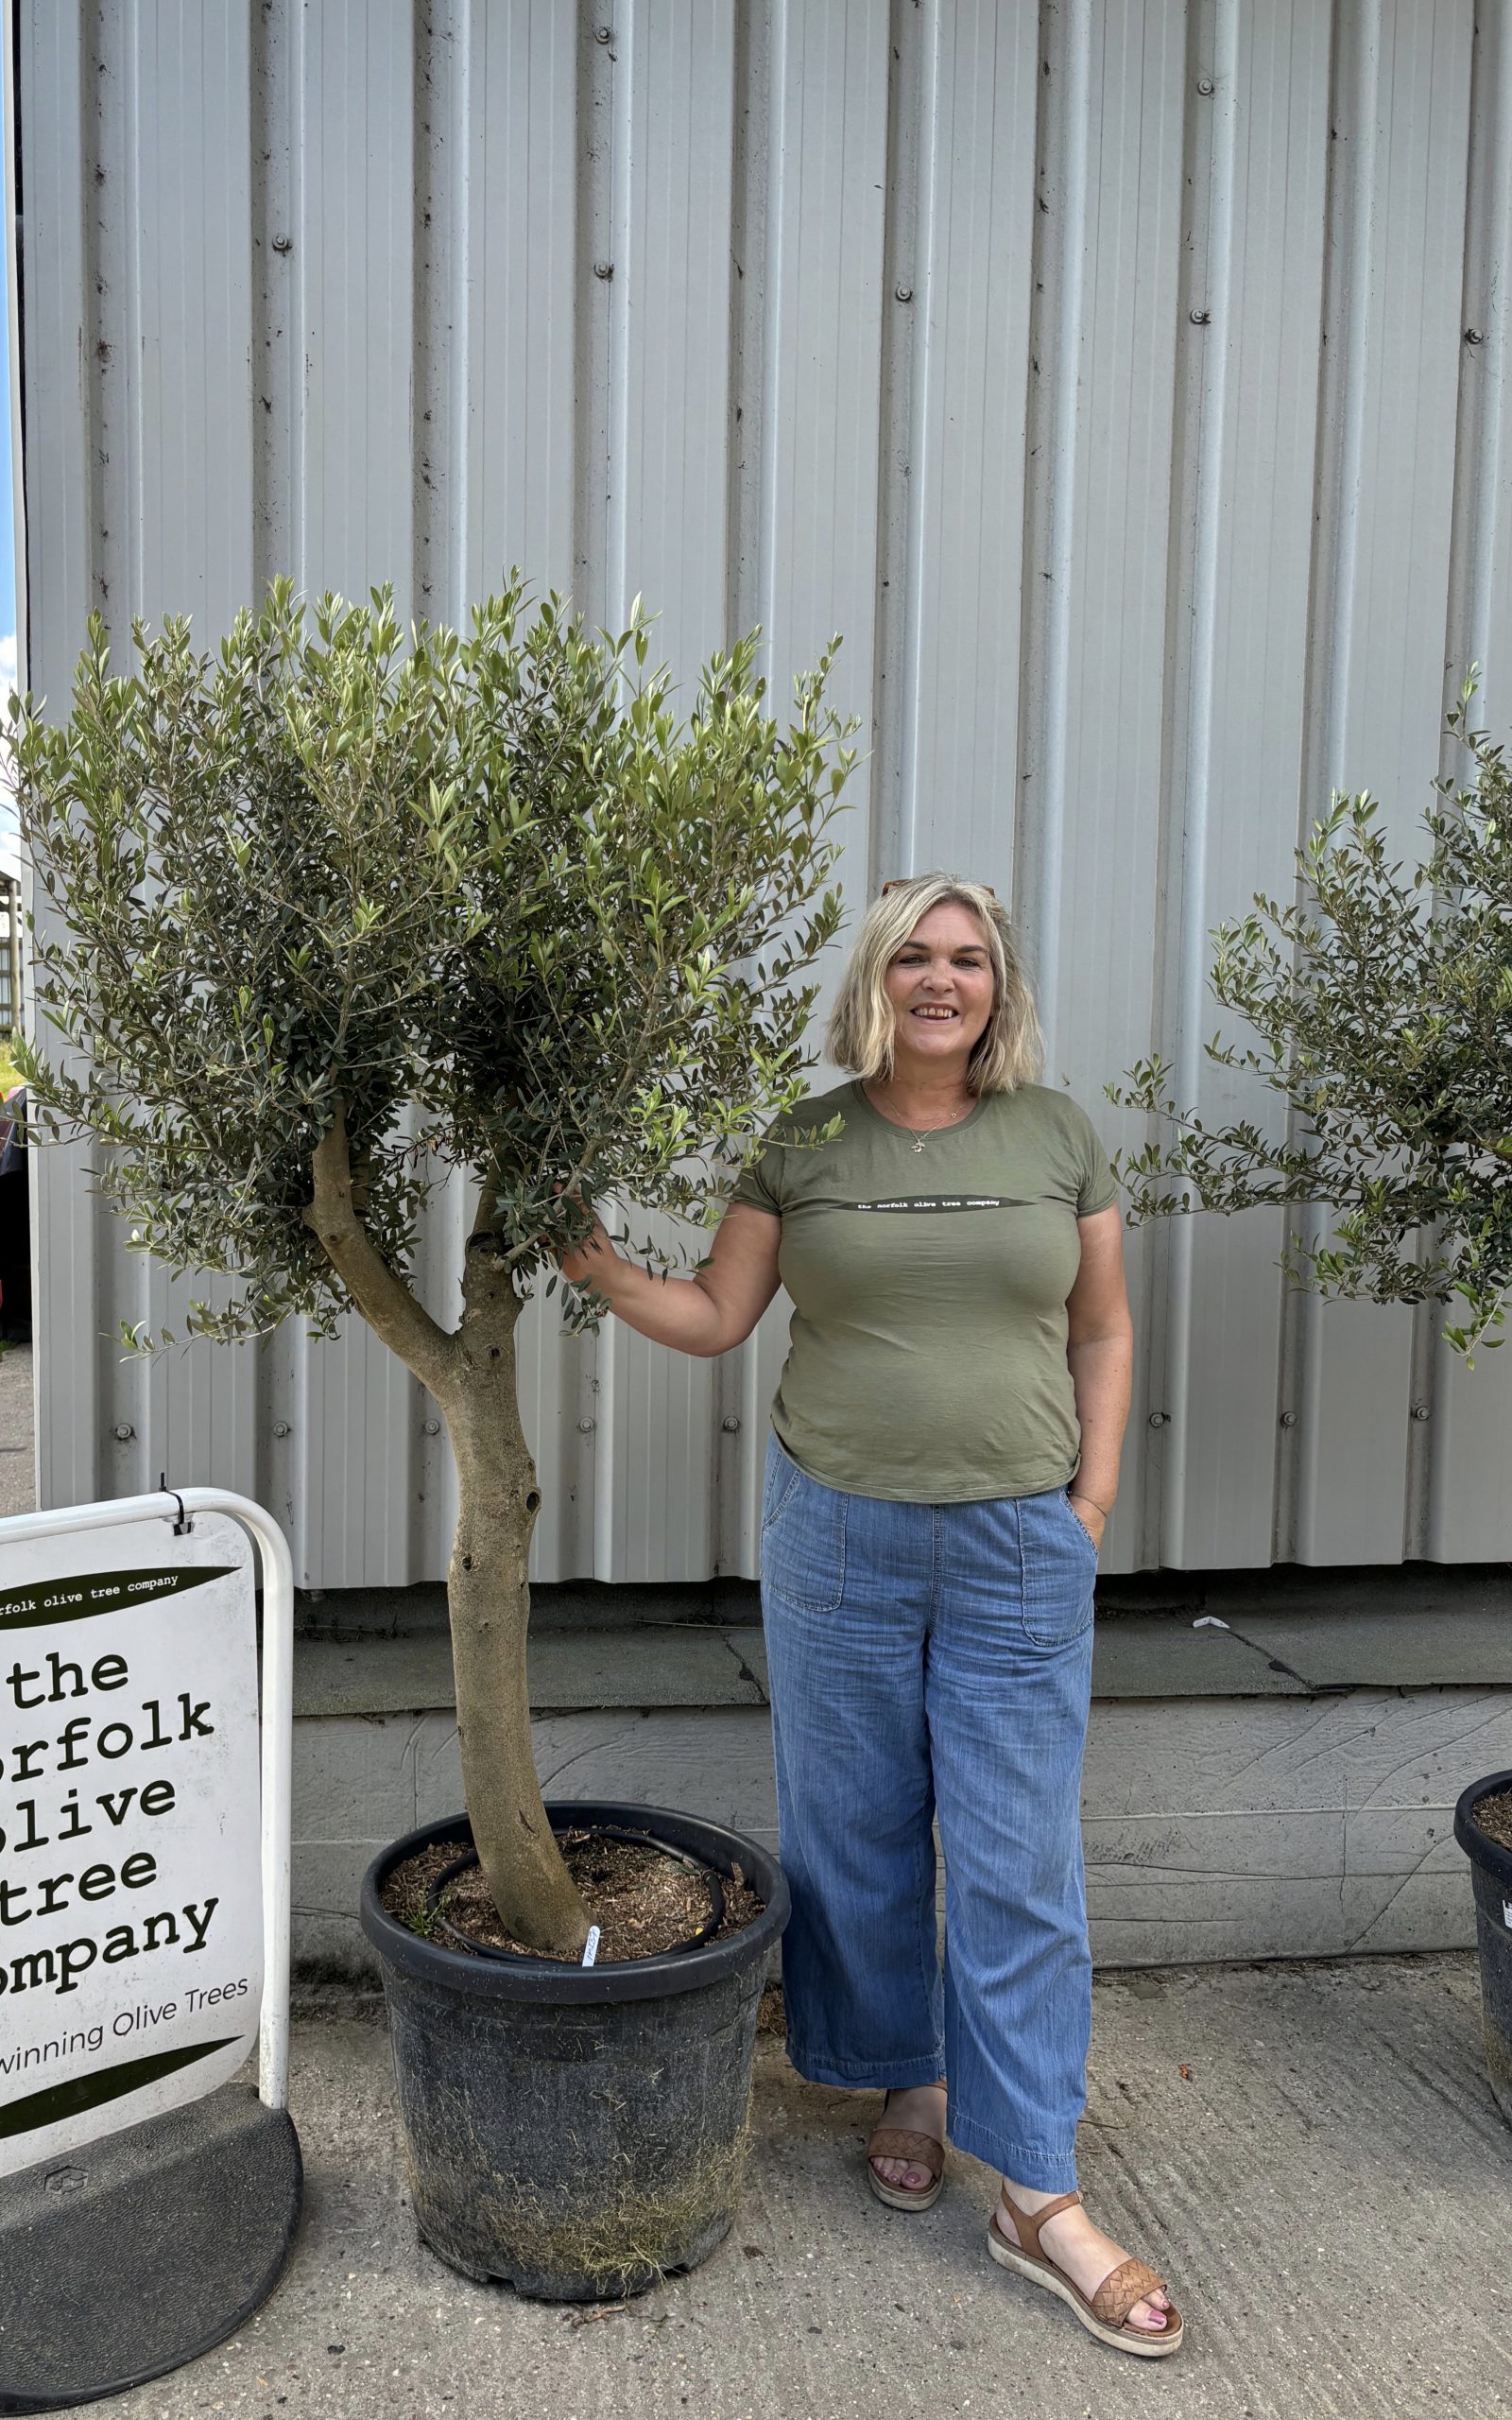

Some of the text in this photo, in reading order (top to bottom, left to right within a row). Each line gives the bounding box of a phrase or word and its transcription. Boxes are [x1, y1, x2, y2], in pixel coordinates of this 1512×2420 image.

[43, 1593, 83, 1608] olive
[90, 1586, 121, 1599] tree
[127, 1575, 179, 1592] company
[6, 1651, 129, 1709] the
[0, 1692, 215, 1783] rfolk
[0, 1779, 176, 1854] live
[0, 1852, 157, 1927] tree
[0, 1897, 219, 1996] mpany
[112, 2001, 178, 2037] Olive
[184, 1978, 249, 2013] Trees
